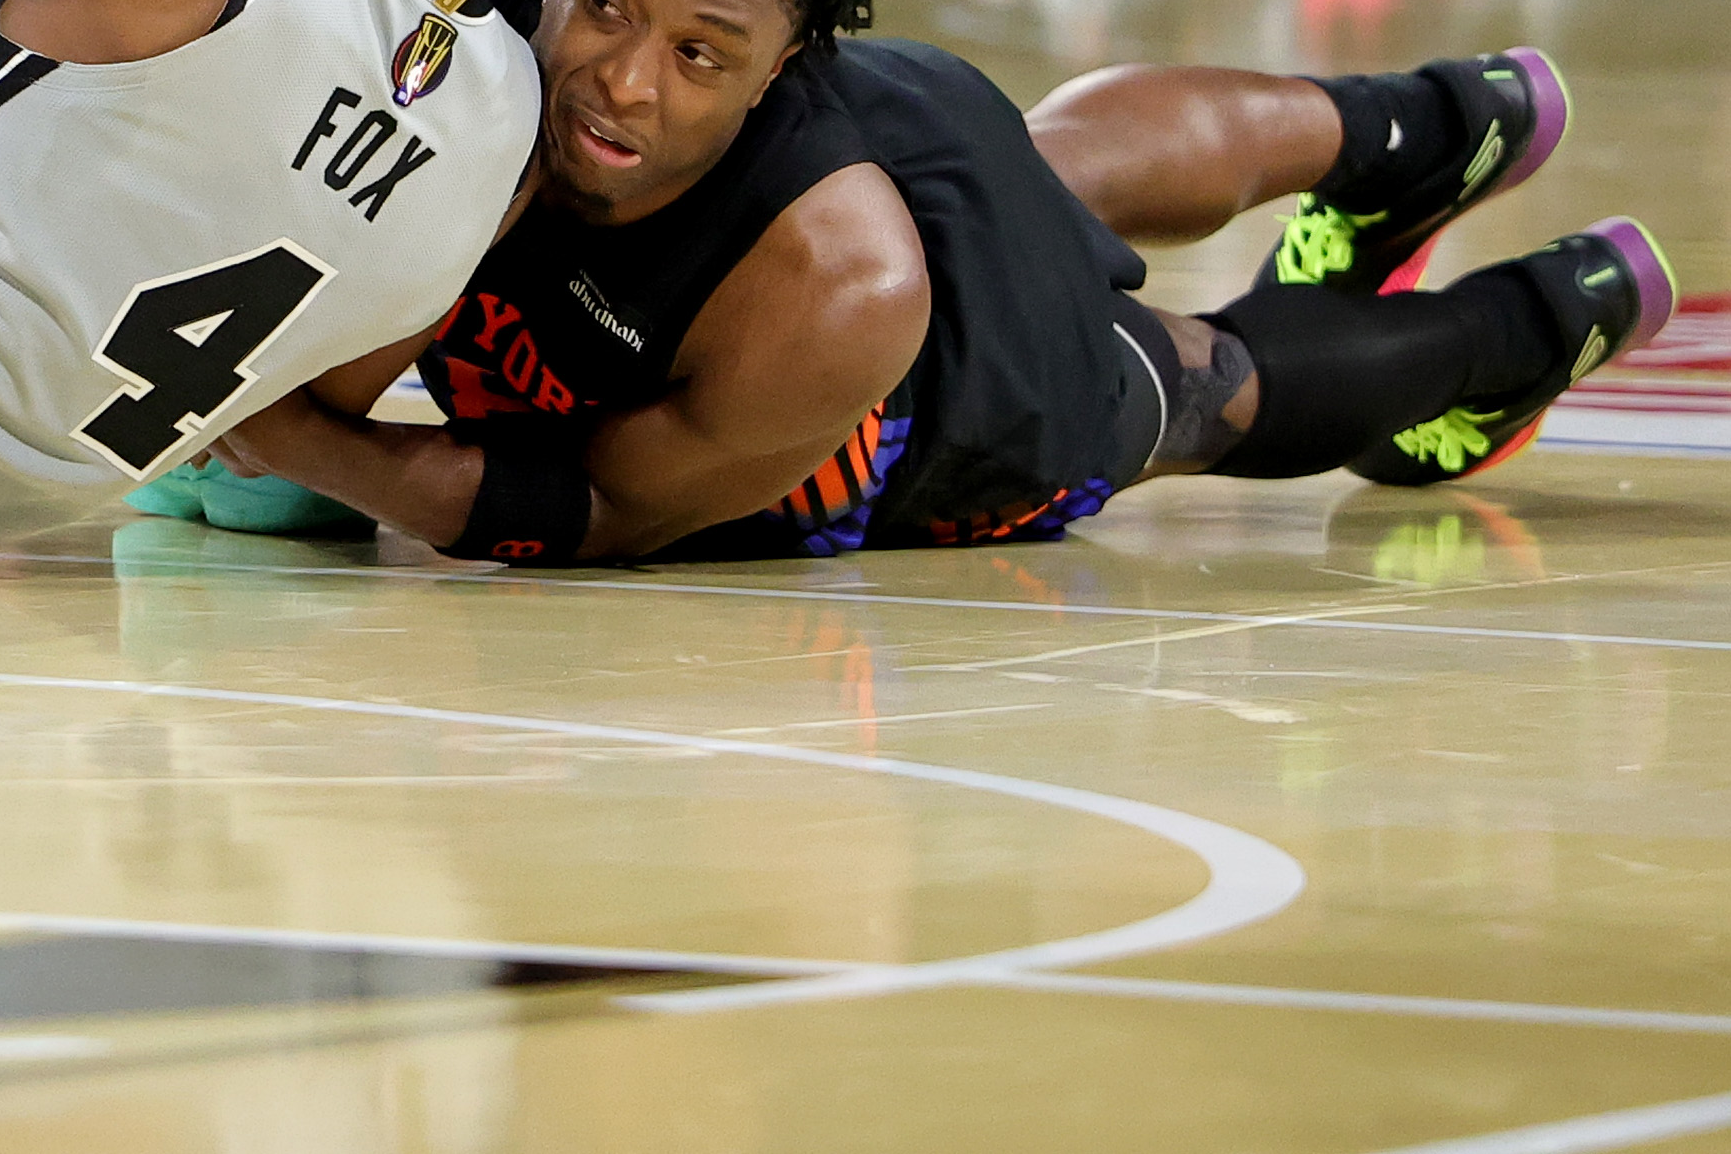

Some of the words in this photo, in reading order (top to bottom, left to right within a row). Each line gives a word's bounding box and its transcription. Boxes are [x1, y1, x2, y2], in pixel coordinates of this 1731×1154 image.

[291, 87, 436, 223] FOX
[69, 236, 339, 482] 4
[473, 292, 581, 415] YOR
[569, 280, 593, 312] abu
[594, 308, 645, 352] dhabi
